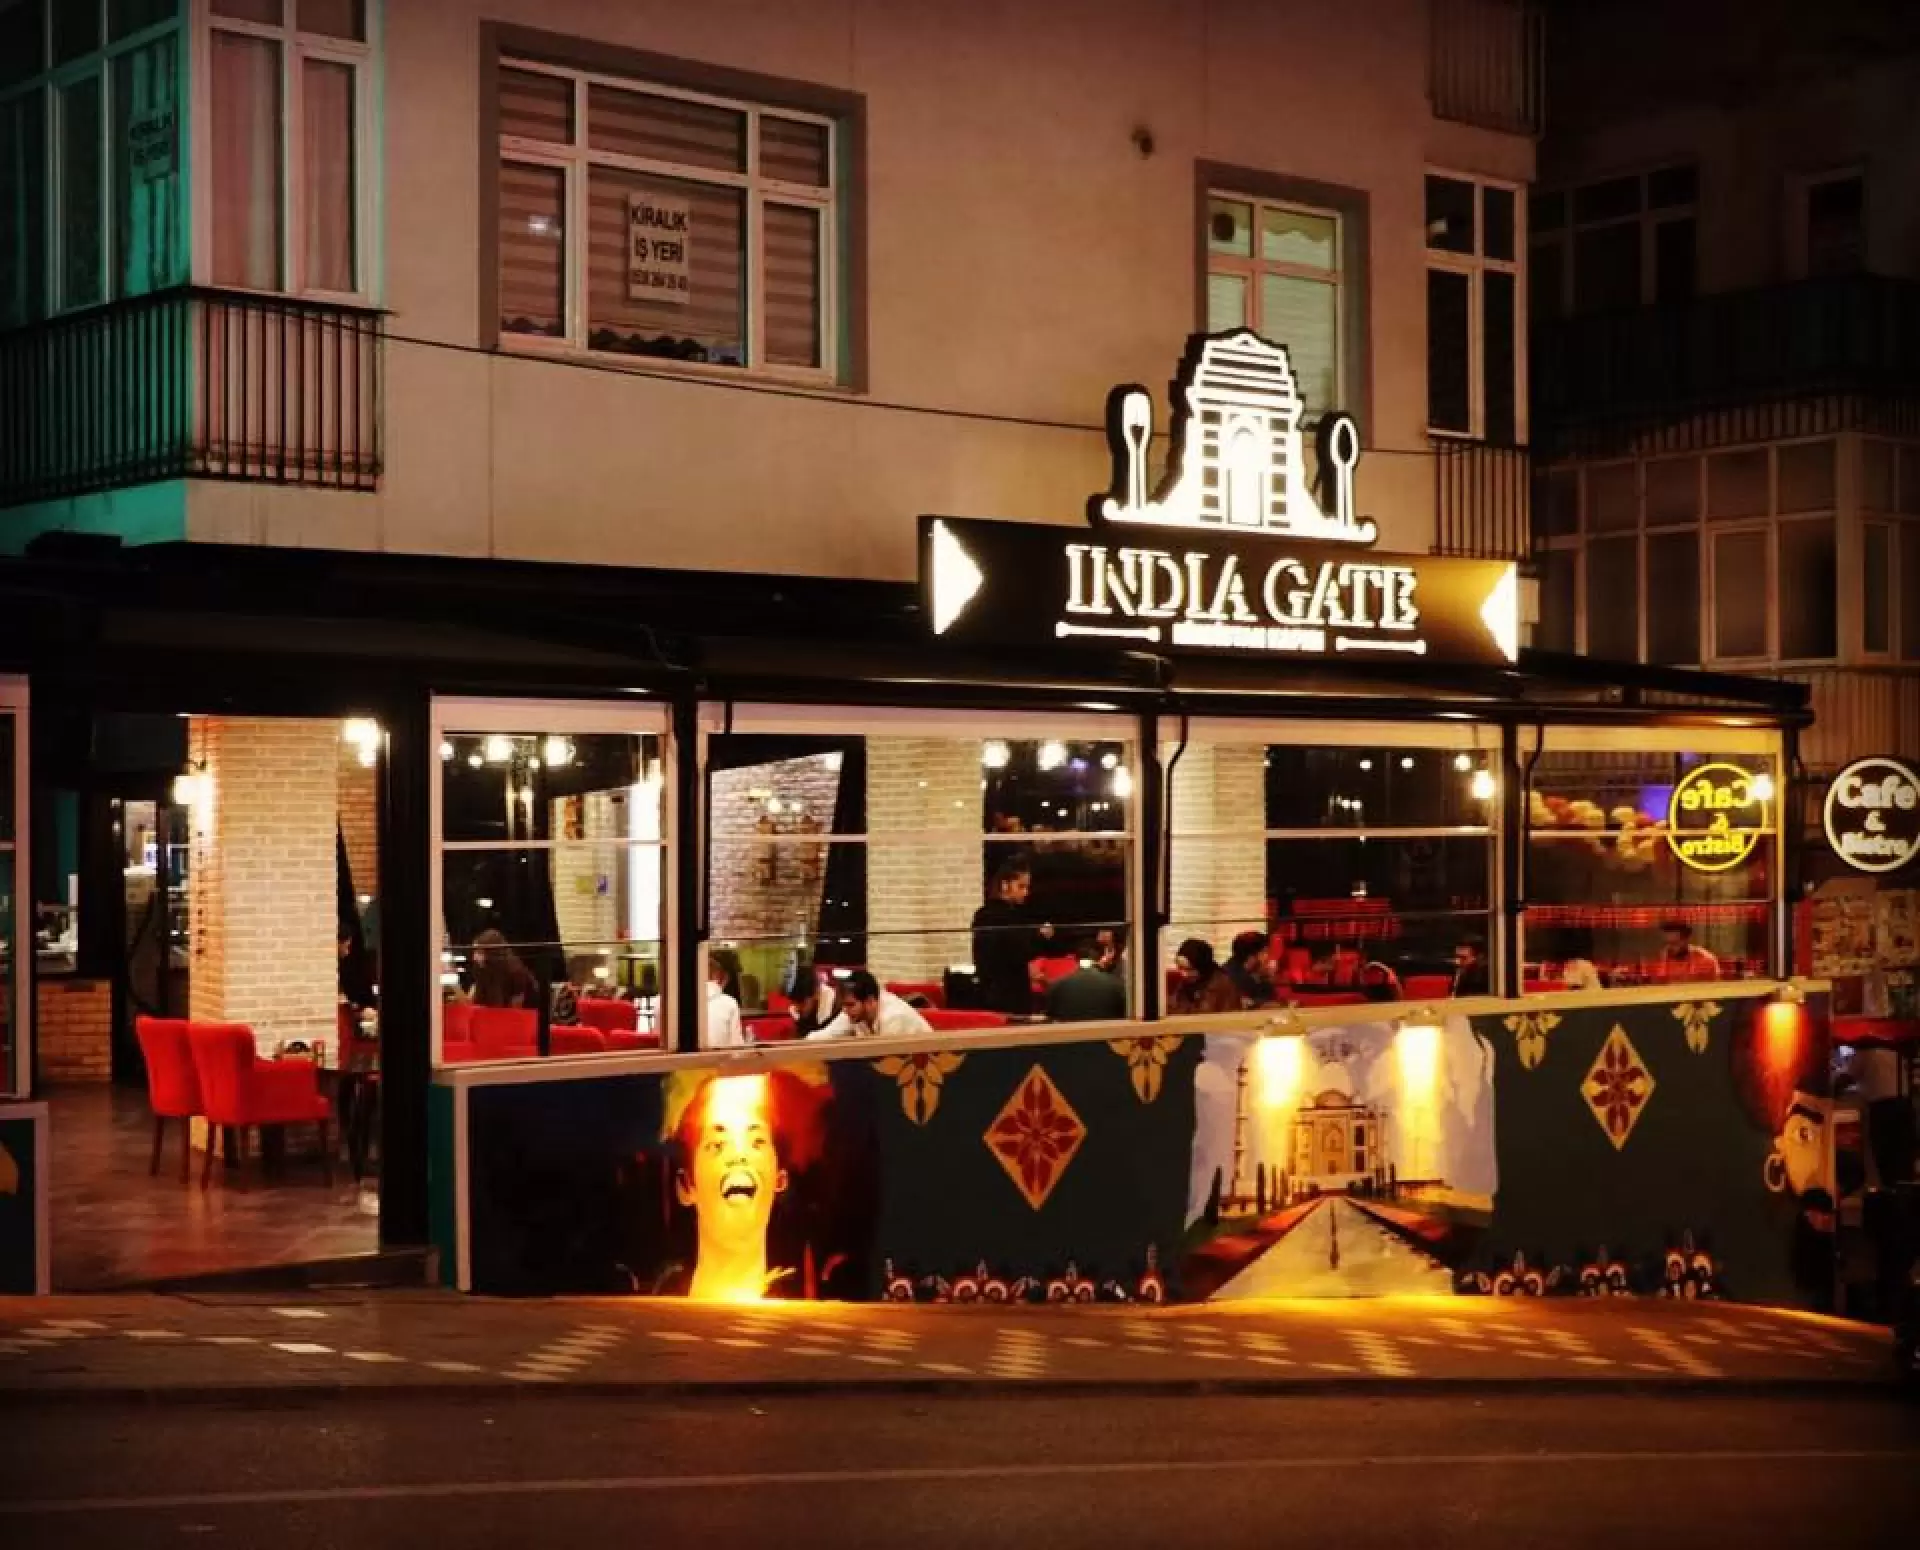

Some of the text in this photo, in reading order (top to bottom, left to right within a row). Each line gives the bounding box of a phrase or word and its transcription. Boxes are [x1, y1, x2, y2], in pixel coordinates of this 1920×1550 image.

[1065, 544, 1418, 629] INDIA GATE
[1837, 775, 1917, 809] Cafe
